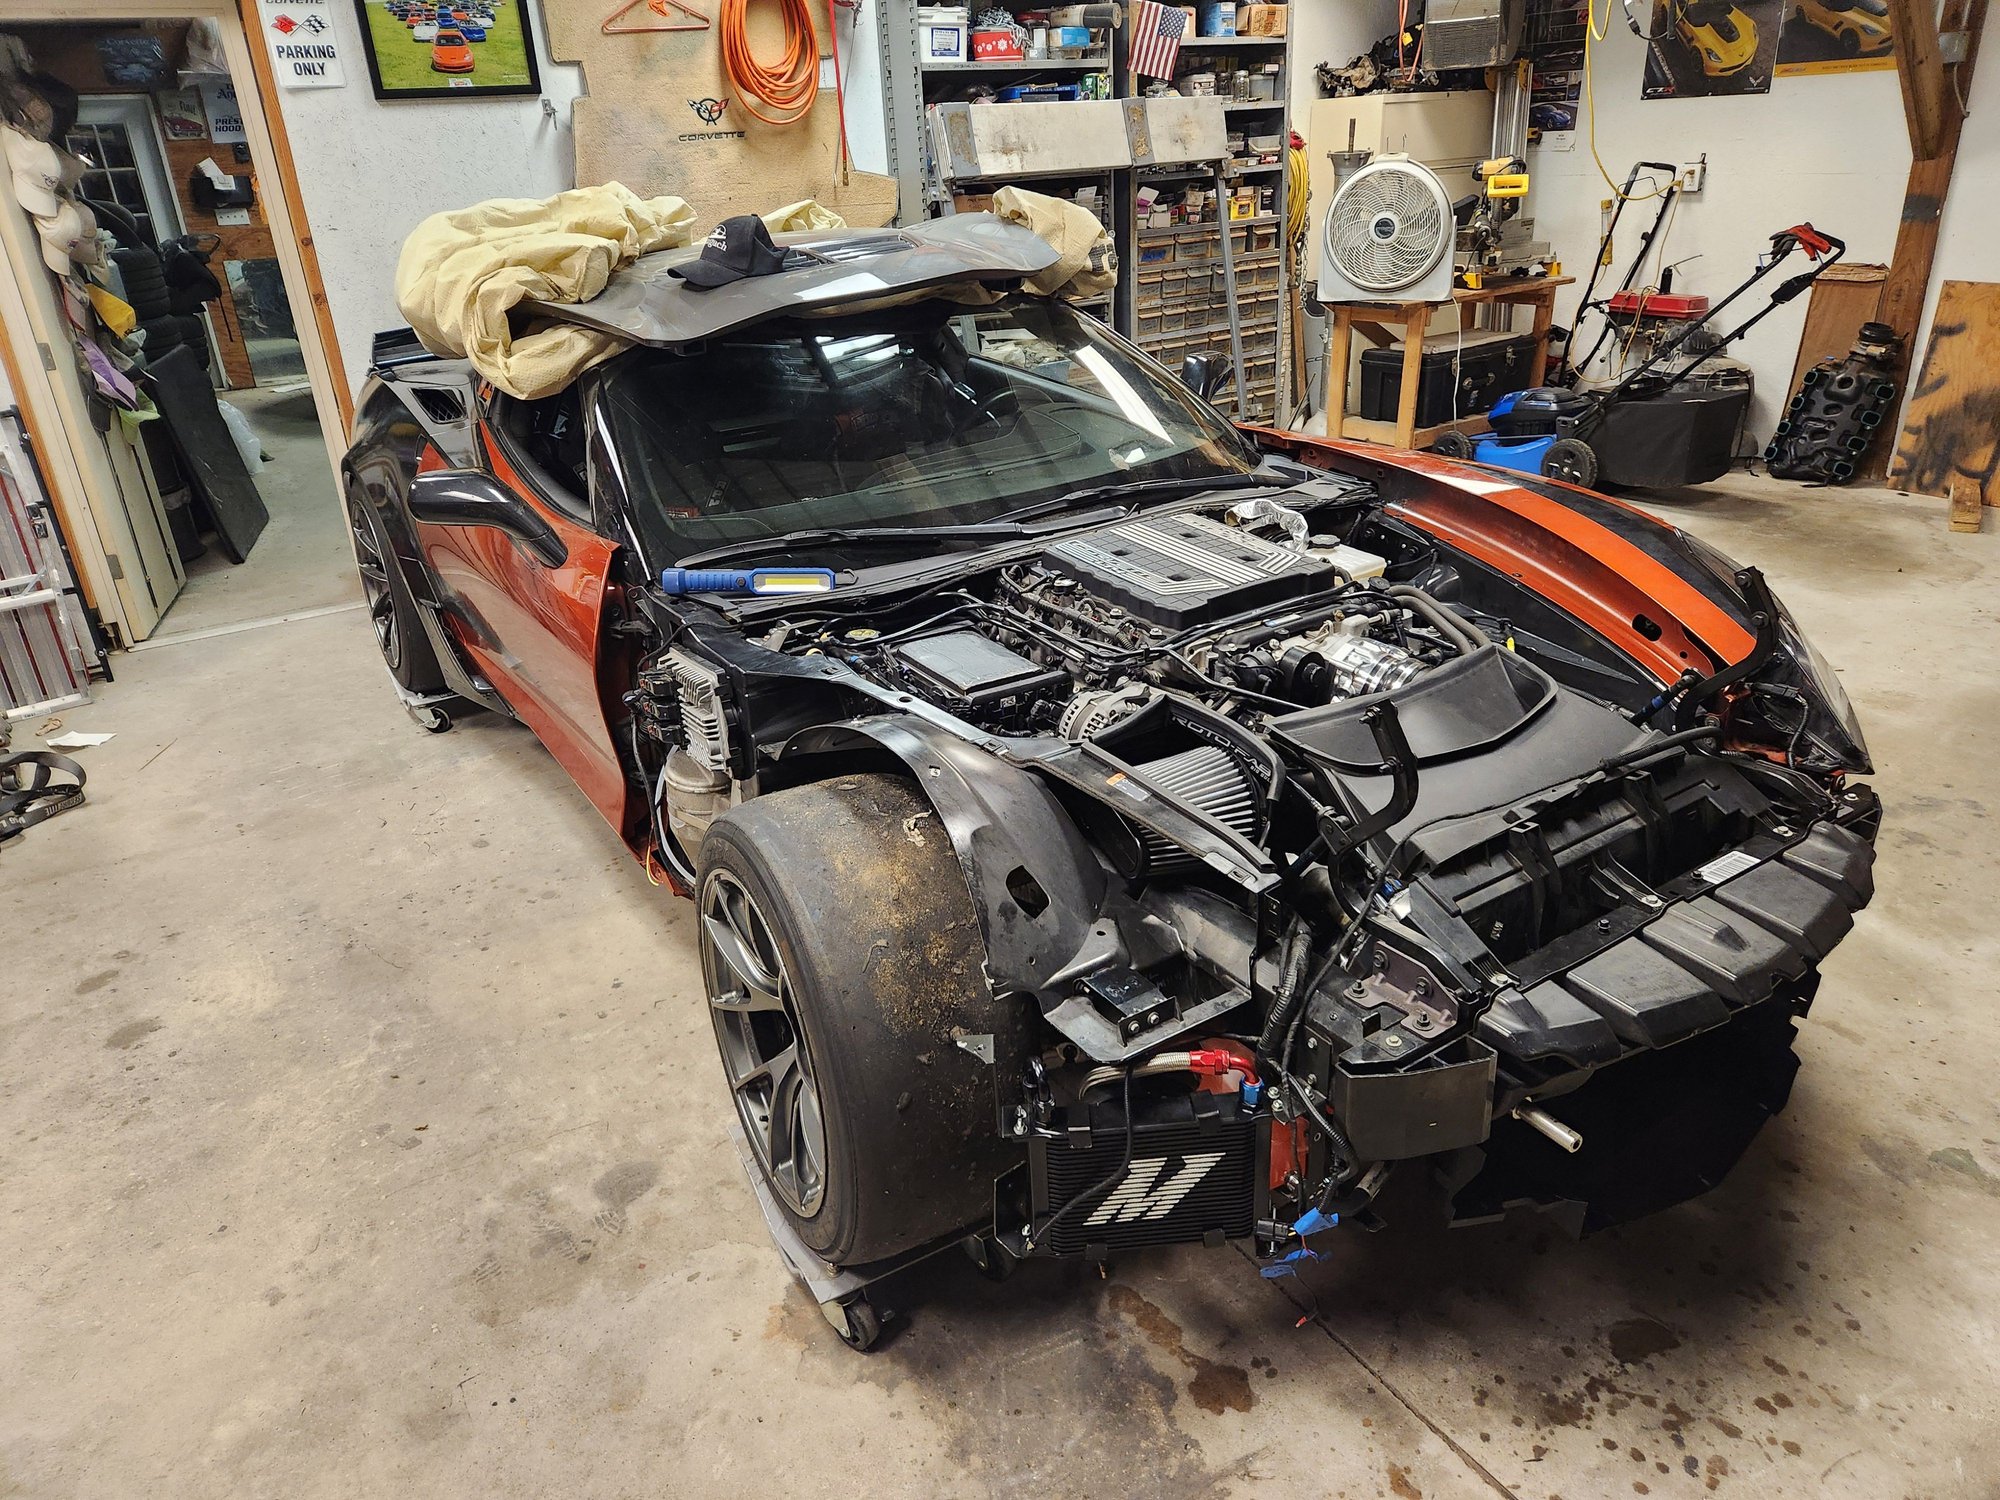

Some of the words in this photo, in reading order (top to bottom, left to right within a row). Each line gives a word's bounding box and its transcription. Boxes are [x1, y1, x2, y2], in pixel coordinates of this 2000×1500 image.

[276, 45, 336, 59] PARKING
[293, 62, 325, 76] ONLY
[679, 131, 745, 142] CORVETTE
[1171, 716, 1272, 778] ROTO-FAB
